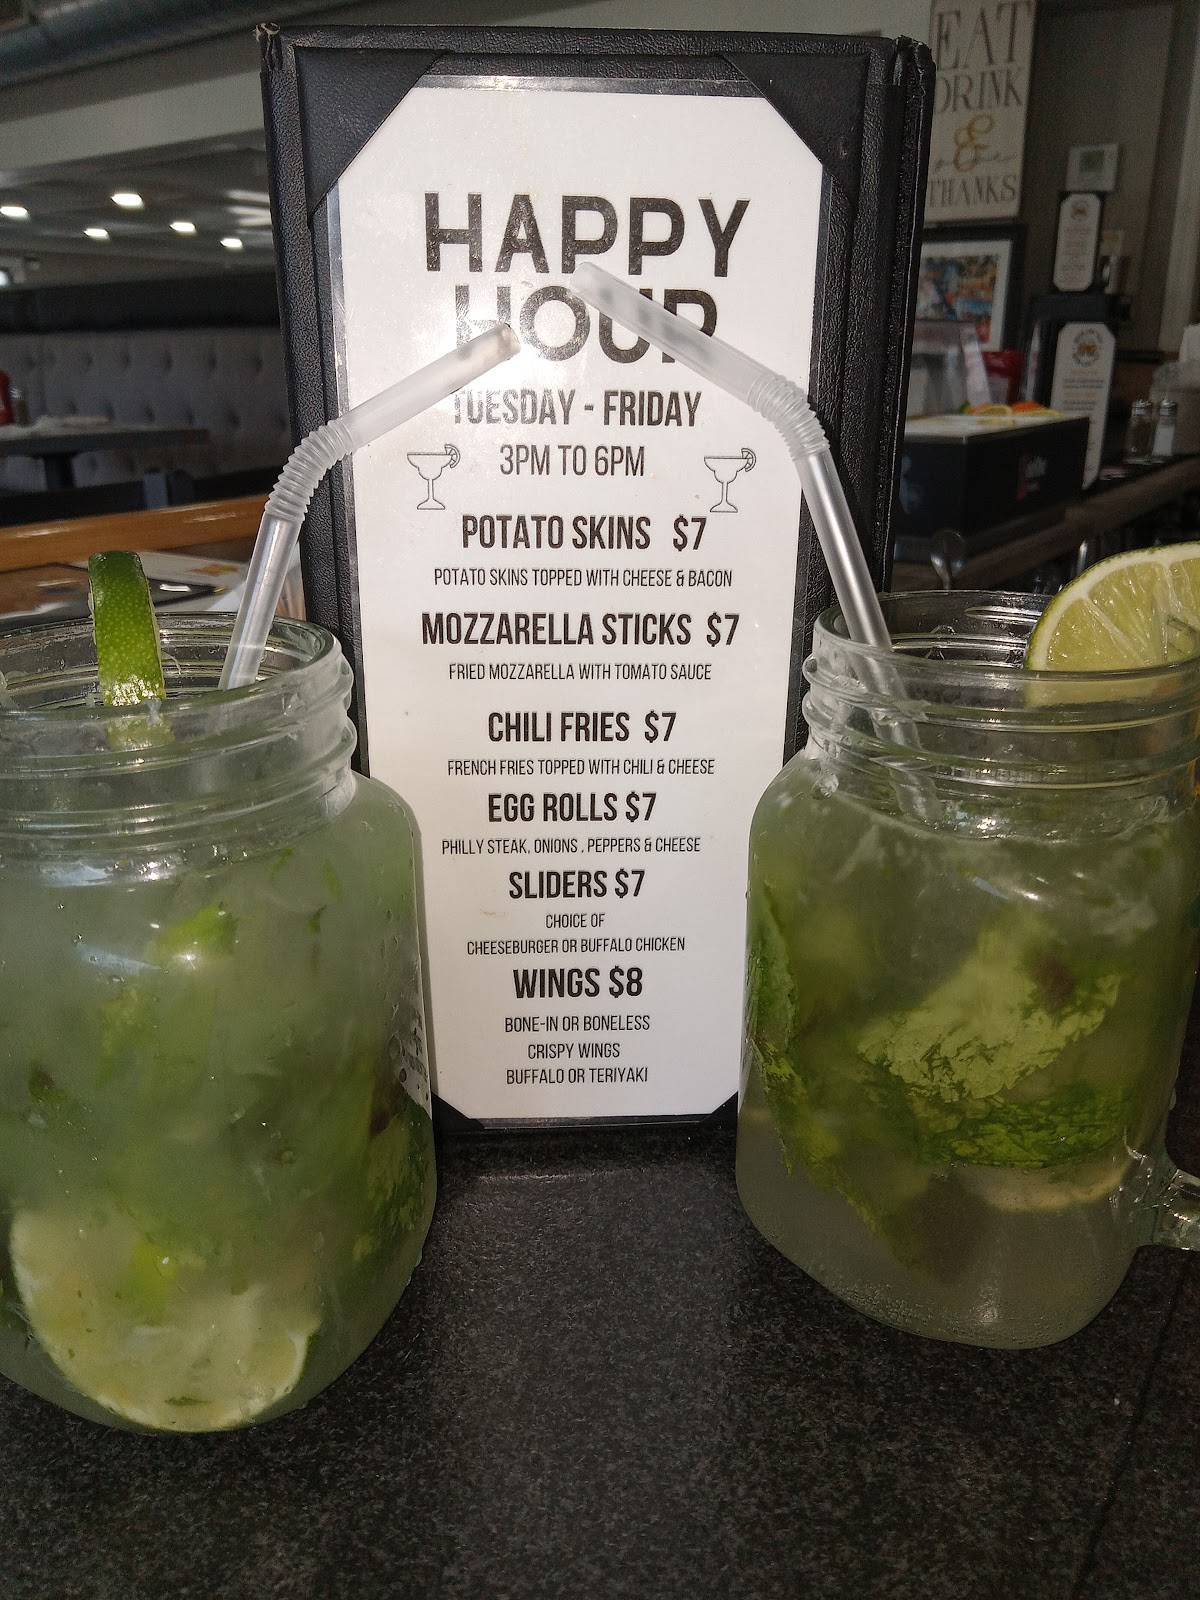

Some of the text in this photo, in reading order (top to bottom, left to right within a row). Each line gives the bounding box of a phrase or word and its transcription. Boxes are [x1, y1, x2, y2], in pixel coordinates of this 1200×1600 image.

[934, 1, 1036, 70] EAT
[934, 67, 1024, 113] DRINK
[929, 175, 1018, 207] THANKS
[424, 191, 751, 277] HAPPY
[453, 388, 576, 425] TUESDAY
[603, 390, 702, 427] FRIDAY
[499, 443, 645, 477] 3PM TO 6PM
[462, 512, 708, 553] POTATO SKINS $7
[434, 567, 733, 588] POTATO SKINS TOPPED WITH CHEESE & BACON
[421, 610, 740, 648] MOZZARELLA STICKS $7
[448, 662, 713, 681] FRIED MOZZARELLA WITH TOMATO SAUCE
[487, 709, 677, 744] CHILI FRIES $7
[447, 758, 716, 777] FRENCH FRIES TOPPED WITH CHILI & CHEESE
[487, 790, 657, 823] EGG ROLLS $7
[441, 838, 485, 856] PHILLY
[587, 837, 641, 854] PEPPERS
[643, 837, 653, 853] &
[655, 836, 701, 853] CHEESE
[508, 867, 646, 900] SLIDERS $7
[545, 912, 606, 929] CHOICE OF
[466, 936, 686, 956] CHEESEBURGER OR BUFFALO CHICKEN
[512, 964, 643, 999] WINGS $8
[504, 1014, 651, 1033] BONE-IN OR BONELESS
[527, 1042, 621, 1060] CRISPY WINGS
[506, 1066, 648, 1085] BUFFALO OR TERIYAKI
